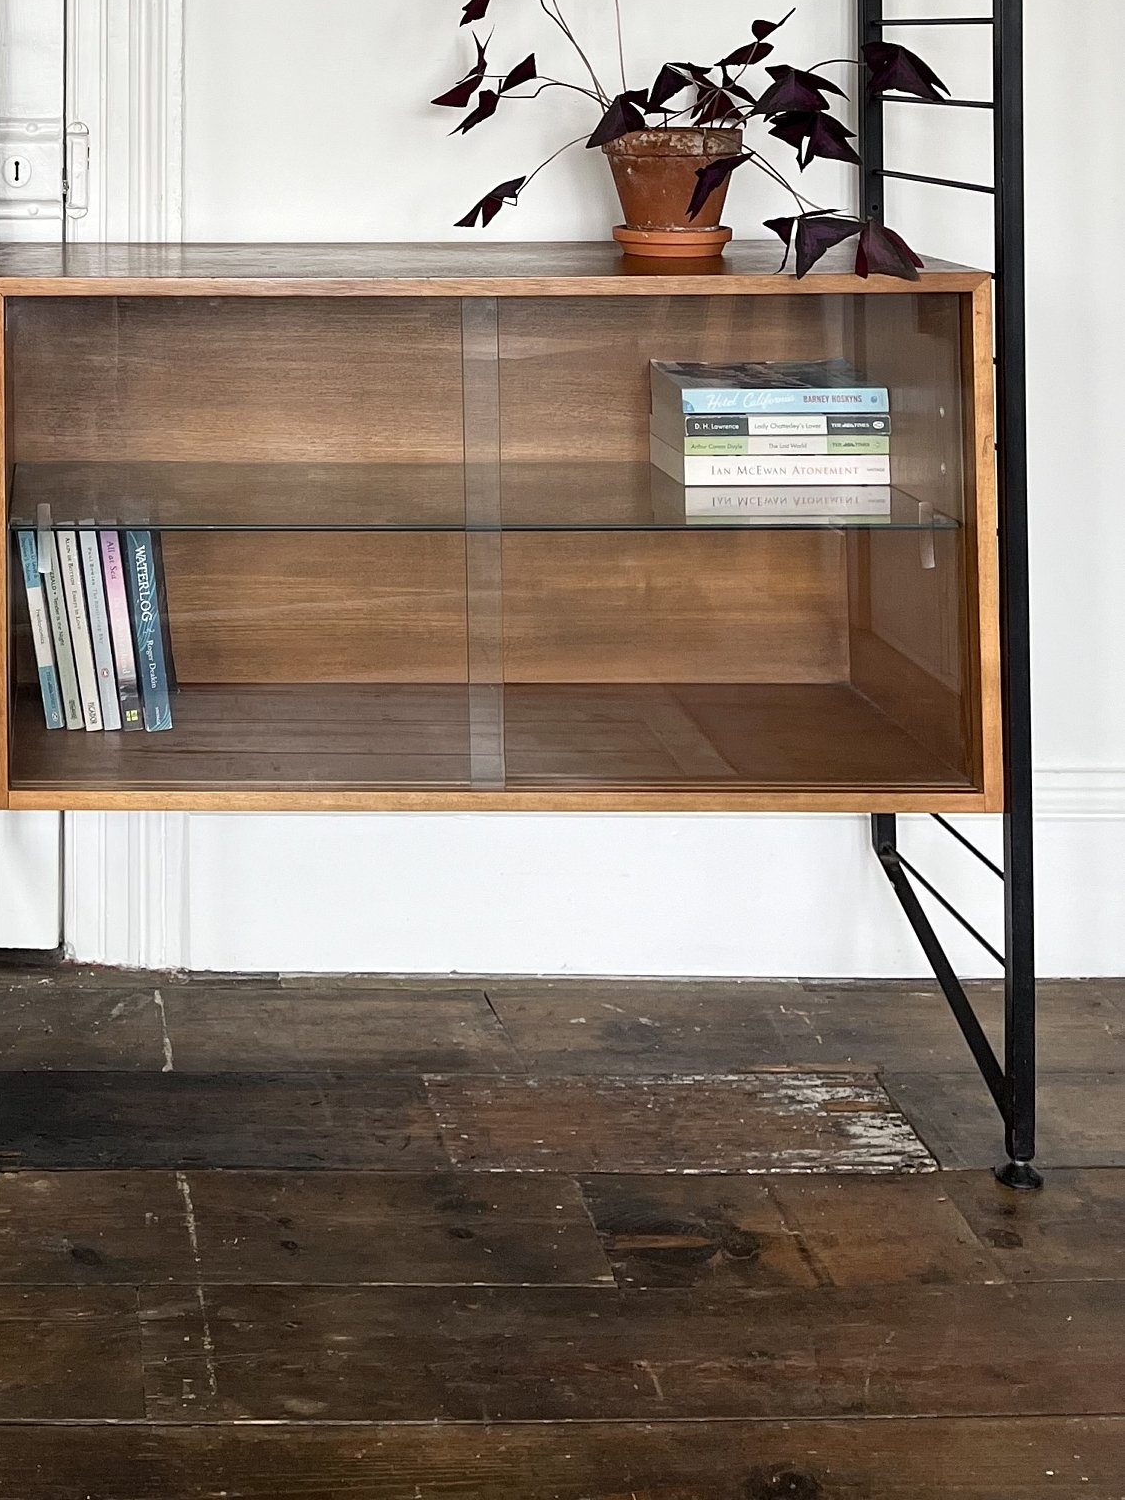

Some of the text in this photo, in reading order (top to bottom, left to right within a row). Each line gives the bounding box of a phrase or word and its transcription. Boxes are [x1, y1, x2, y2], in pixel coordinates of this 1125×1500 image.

[706, 391, 863, 409] Hotel California BARNEY HOSKYNS
[694, 422, 740, 430] D. H. Lawrence
[754, 422, 774, 432] Lady
[805, 421, 821, 430] Lover
[690, 442, 707, 450] Arthur
[724, 442, 743, 451] Doyle
[768, 442, 778, 450] The
[778, 442, 789, 450] Lost
[711, 465, 732, 476] IAN
[791, 465, 860, 476] ATONEMENT
[106, 540, 117, 580] All at Sea
[134, 545, 153, 622] WATERLOG
[52, 597, 62, 615] Tender
[57, 631, 65, 646] Night
[146, 640, 157, 689] Roger Deakin
